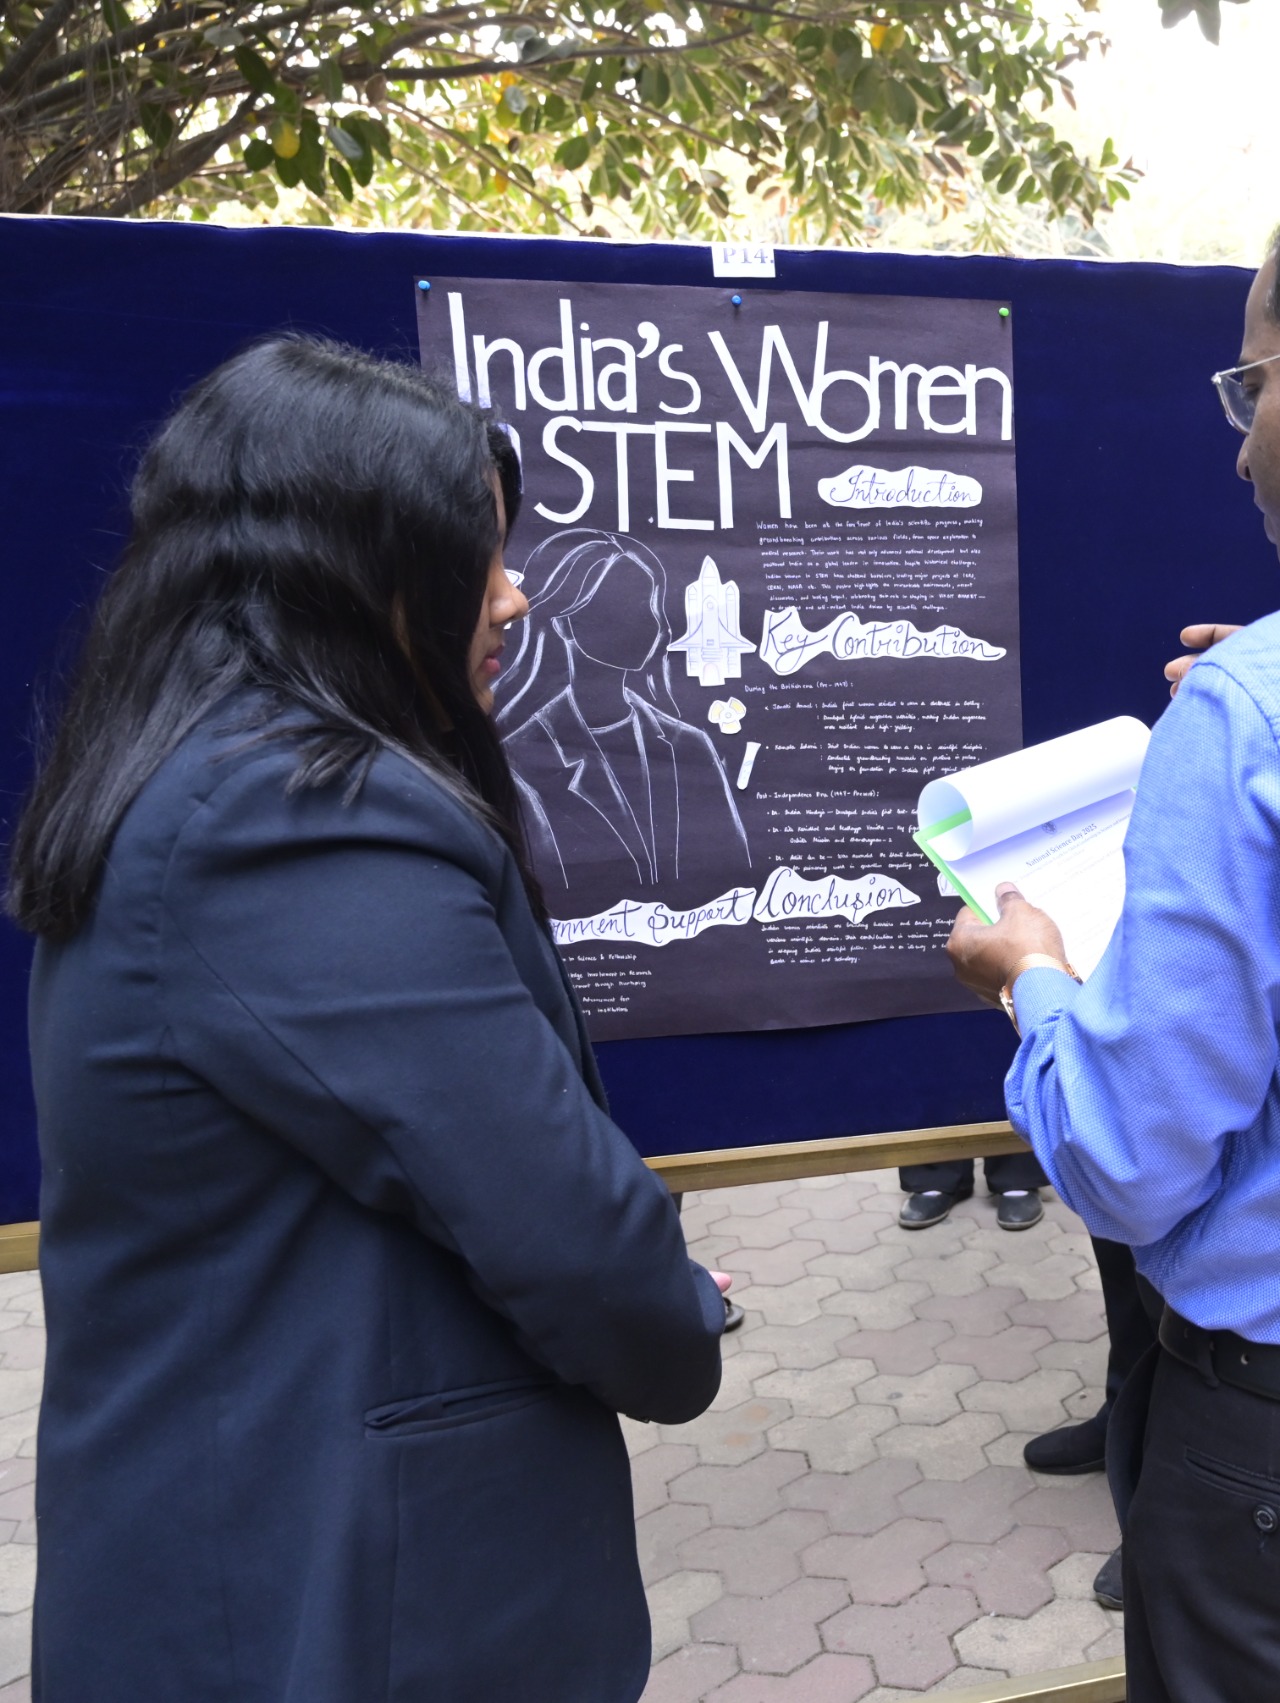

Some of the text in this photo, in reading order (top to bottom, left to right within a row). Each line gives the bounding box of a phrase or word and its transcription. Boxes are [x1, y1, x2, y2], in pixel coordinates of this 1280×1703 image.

[723, 248, 774, 264] P14.
[448, 292, 1014, 442] India's Women
[533, 416, 792, 533] STEM
[830, 469, 977, 505] Introduction
[756, 521, 778, 529] Women
[964, 519, 983, 527] making
[763, 611, 1001, 673] Key Contribution
[745, 685, 765, 694] During
[1025, 850, 1051, 867] National
[1050, 838, 1072, 853] Science
[1071, 830, 1083, 843] Day
[1082, 823, 1098, 835] 2025
[552, 889, 754, 943] rnment Support
[758, 869, 916, 922] Conclusion
